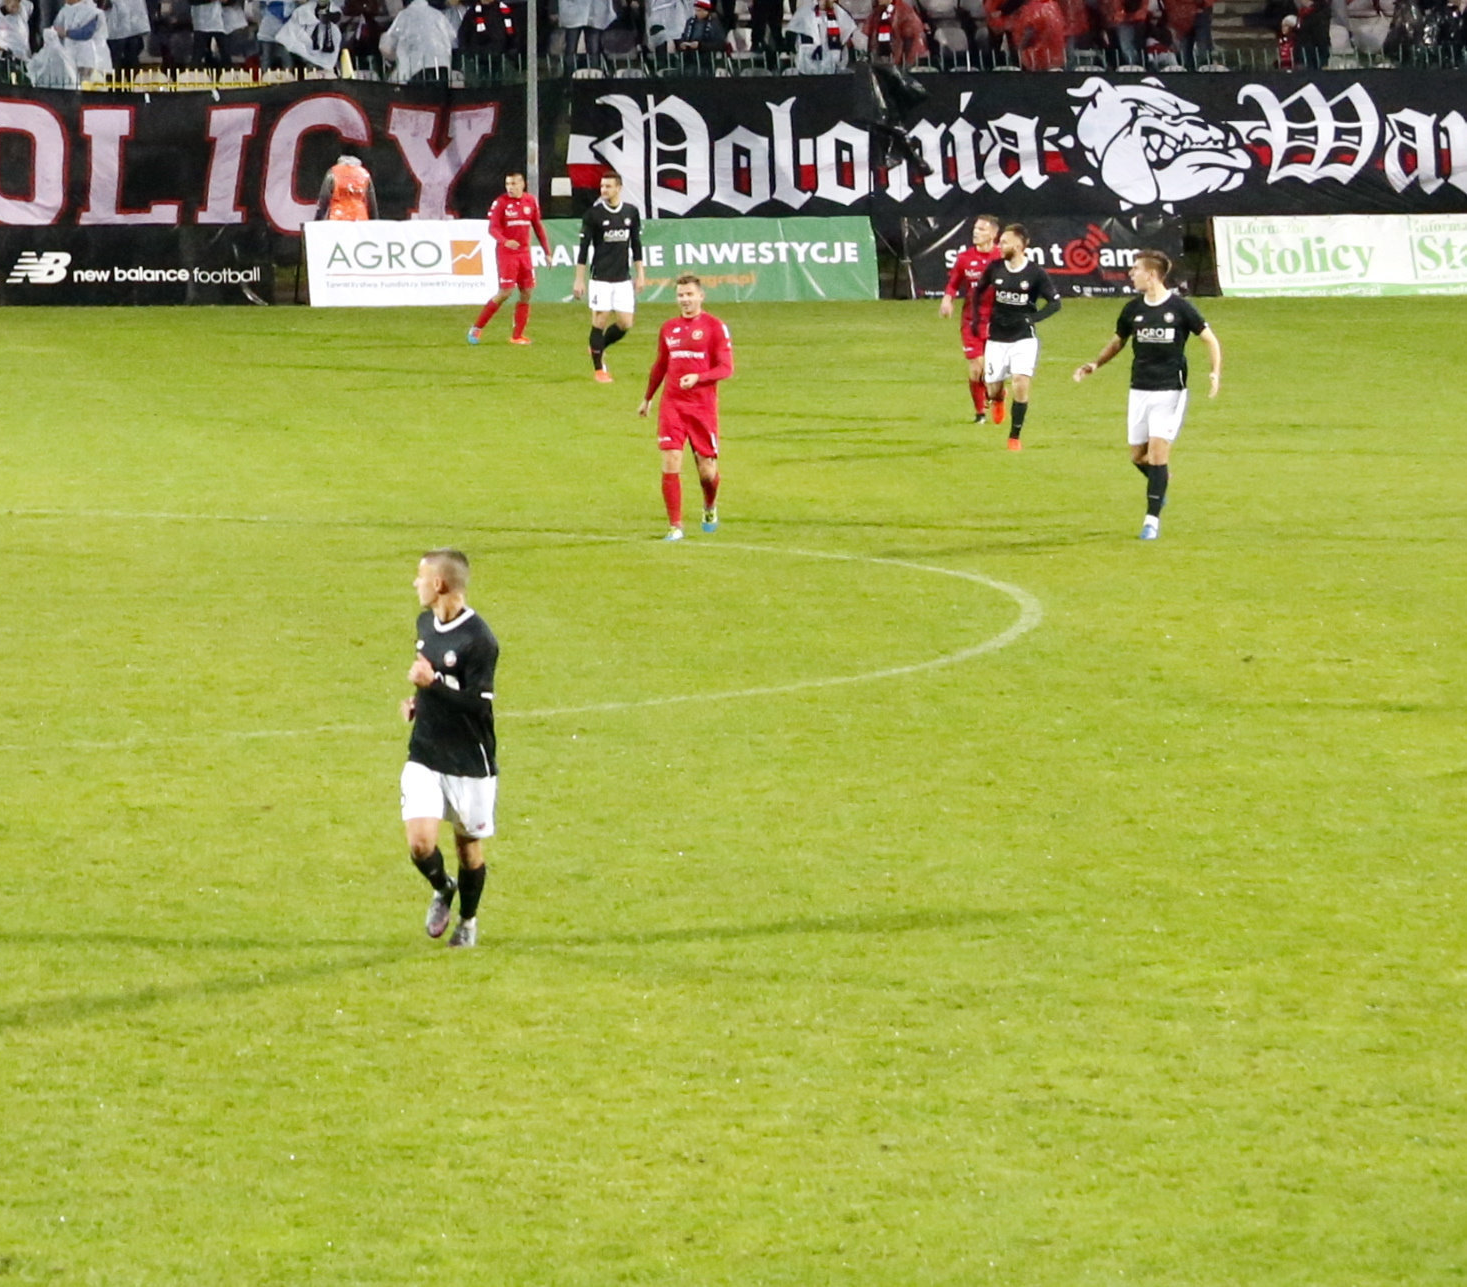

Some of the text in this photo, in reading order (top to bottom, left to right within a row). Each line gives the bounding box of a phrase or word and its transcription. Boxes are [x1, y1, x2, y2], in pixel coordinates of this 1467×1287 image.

[594, 92, 1051, 219] Polonia
[327, 240, 442, 269] AGRO
[675, 242, 858, 265] INWESTYCJE
[1235, 236, 1374, 278] Stolicy
[73, 268, 110, 283] new
[114, 266, 190, 282] balance
[193, 266, 261, 283] football
[1137, 327, 1165, 337] AGRO
